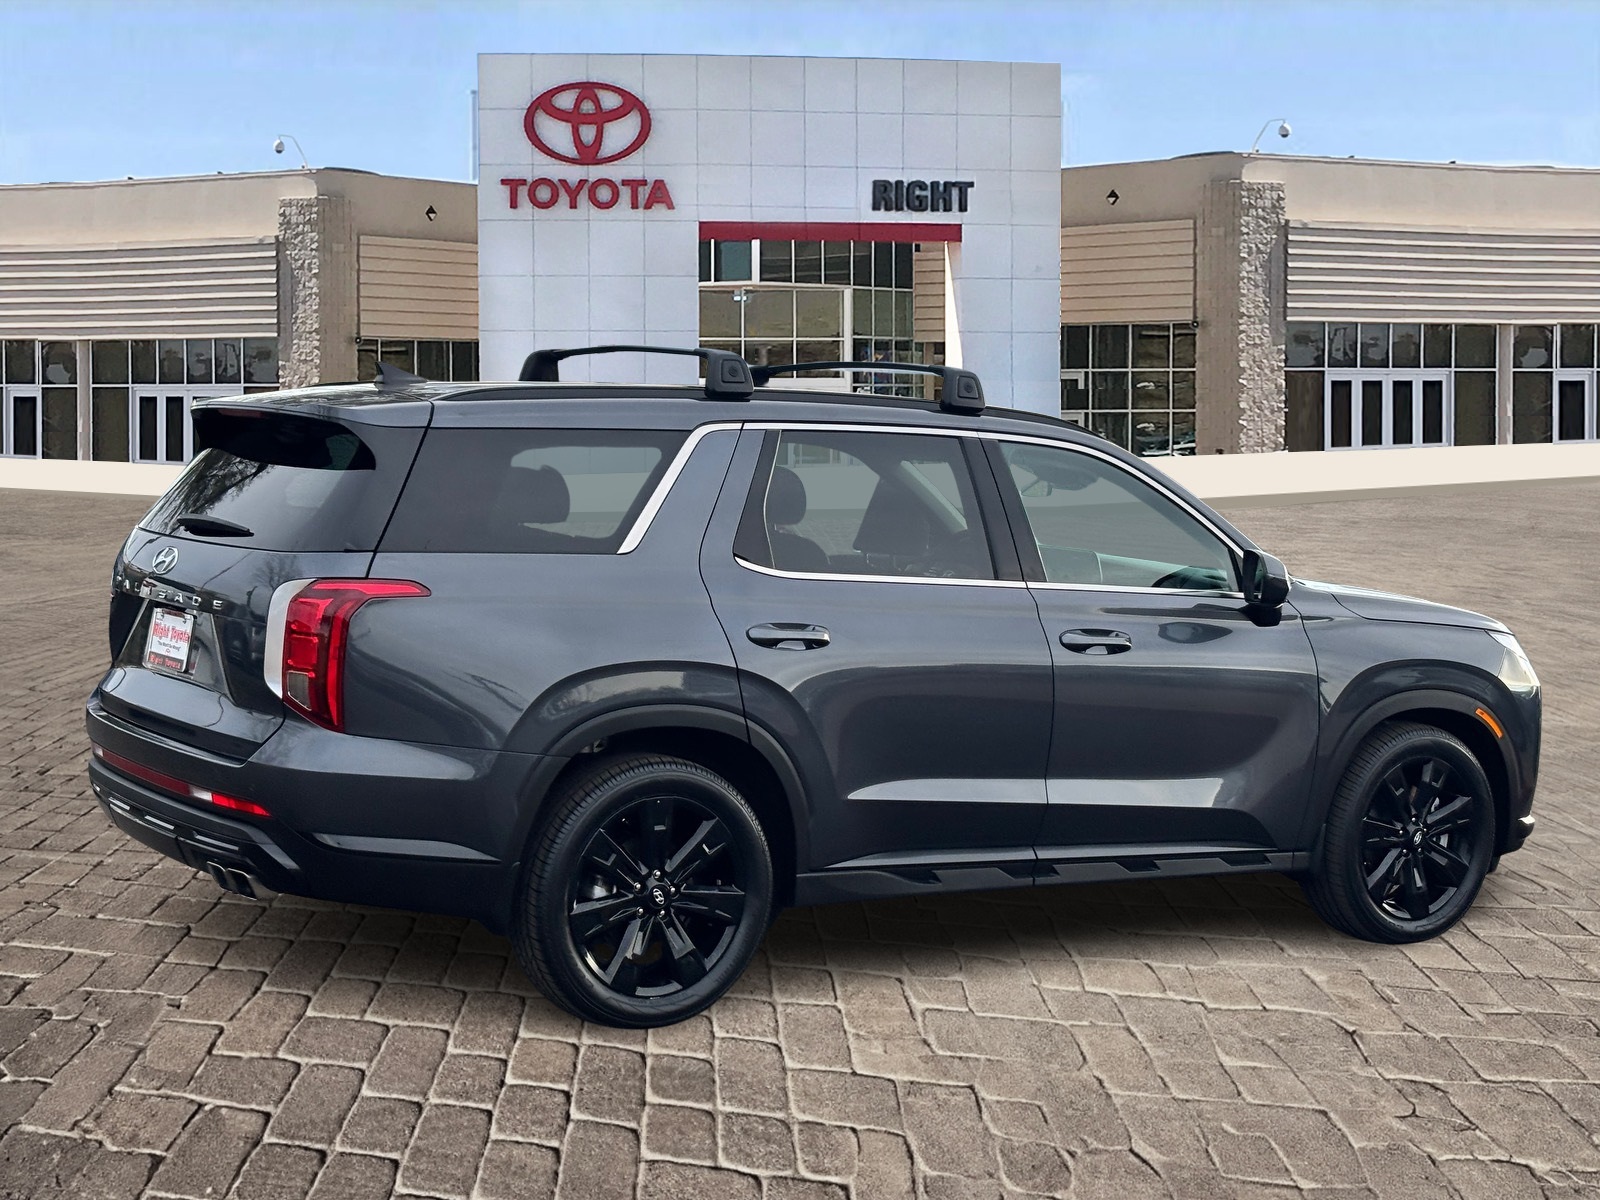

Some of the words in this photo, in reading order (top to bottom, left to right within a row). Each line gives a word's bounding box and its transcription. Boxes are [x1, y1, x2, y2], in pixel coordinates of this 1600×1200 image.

[500, 178, 675, 210] TOYOTA
[872, 179, 976, 213] RIGHT
[153, 622, 169, 641] Right
[170, 625, 190, 644] Toyota
